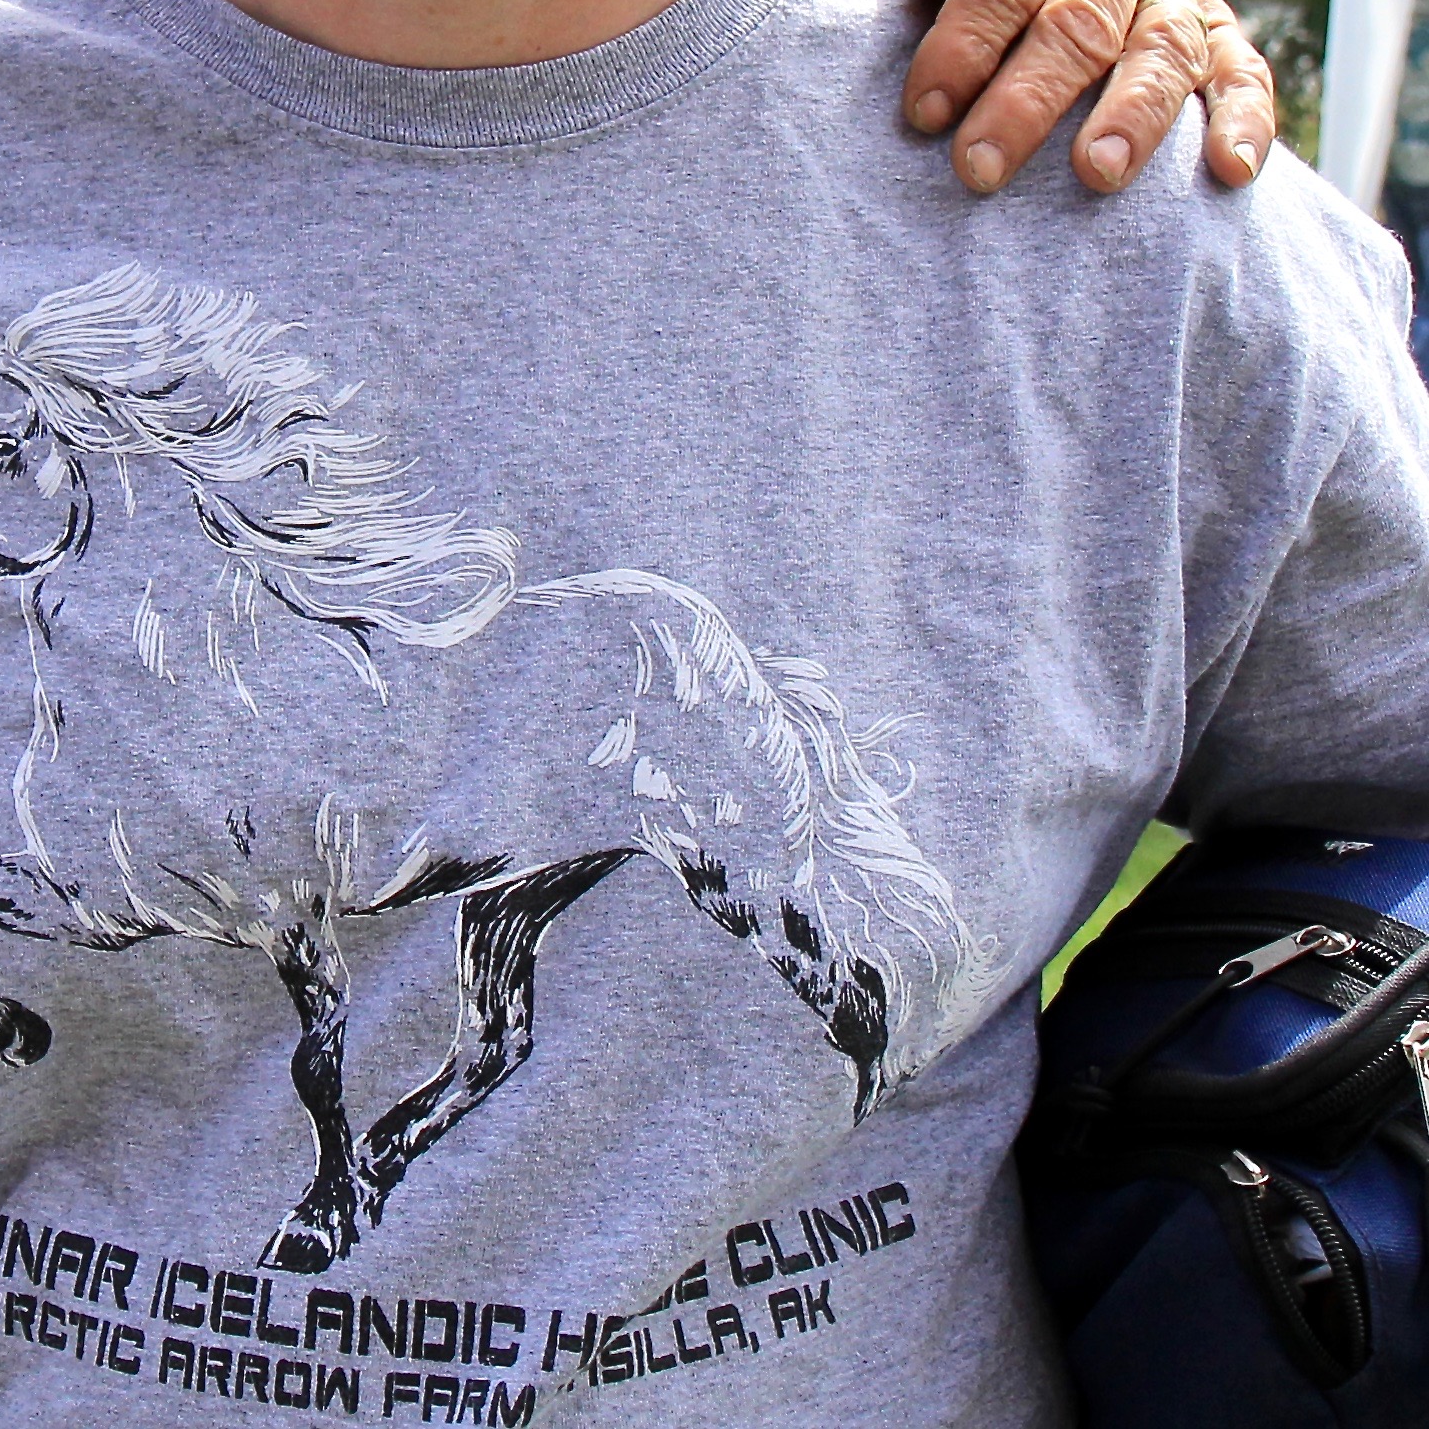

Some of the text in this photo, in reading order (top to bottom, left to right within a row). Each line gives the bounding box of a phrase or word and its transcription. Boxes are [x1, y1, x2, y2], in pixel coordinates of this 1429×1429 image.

[149, 1256, 527, 1368] ICELANDIC
[725, 1181, 917, 1288] CLINIC
[158, 1336, 362, 1415] ARROW
[382, 1371, 537, 1429] FARM
[556, 1302, 761, 1393] SILLA,
[768, 1278, 837, 1340] AK
